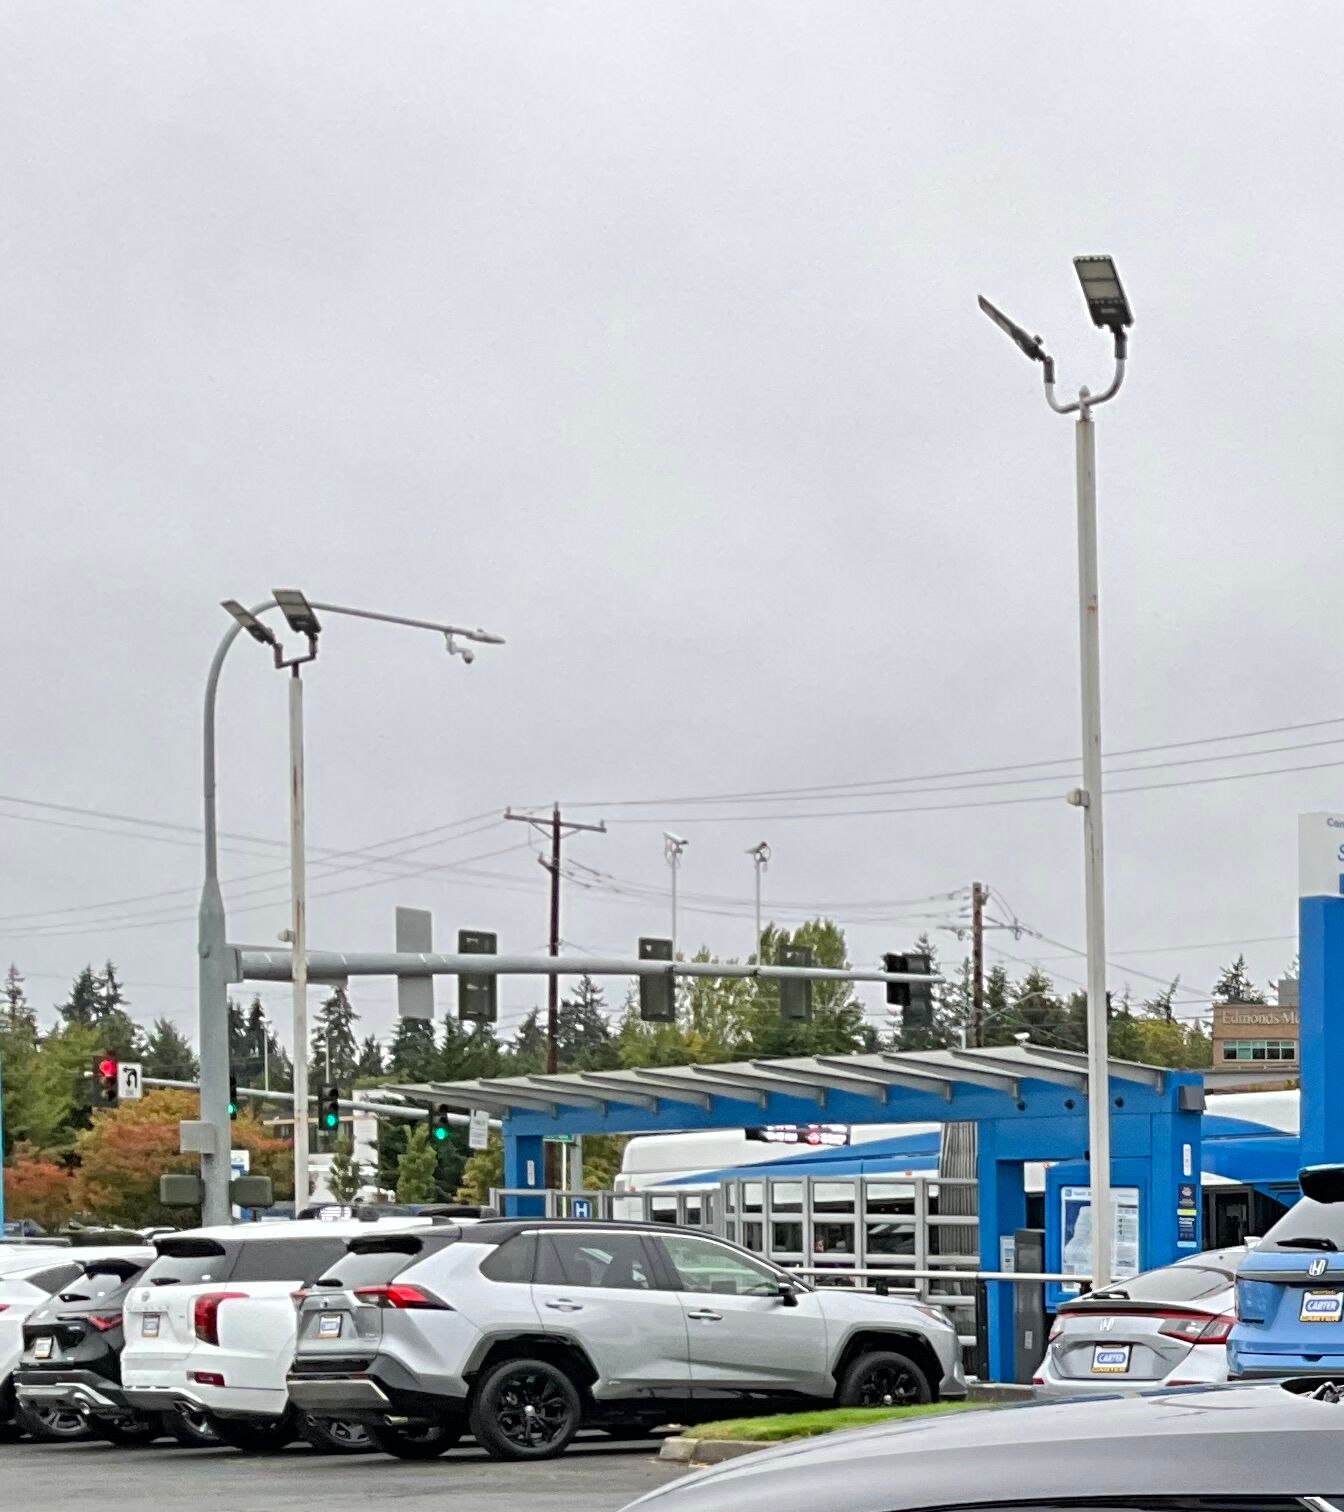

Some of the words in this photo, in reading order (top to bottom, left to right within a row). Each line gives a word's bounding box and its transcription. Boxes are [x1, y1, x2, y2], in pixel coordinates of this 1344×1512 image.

[1222, 1009, 1280, 1025] Edmonds
[575, 1202, 588, 1218] H
[1306, 1300, 1338, 1311] CARTER
[1098, 1353, 1126, 1363] CARTER
